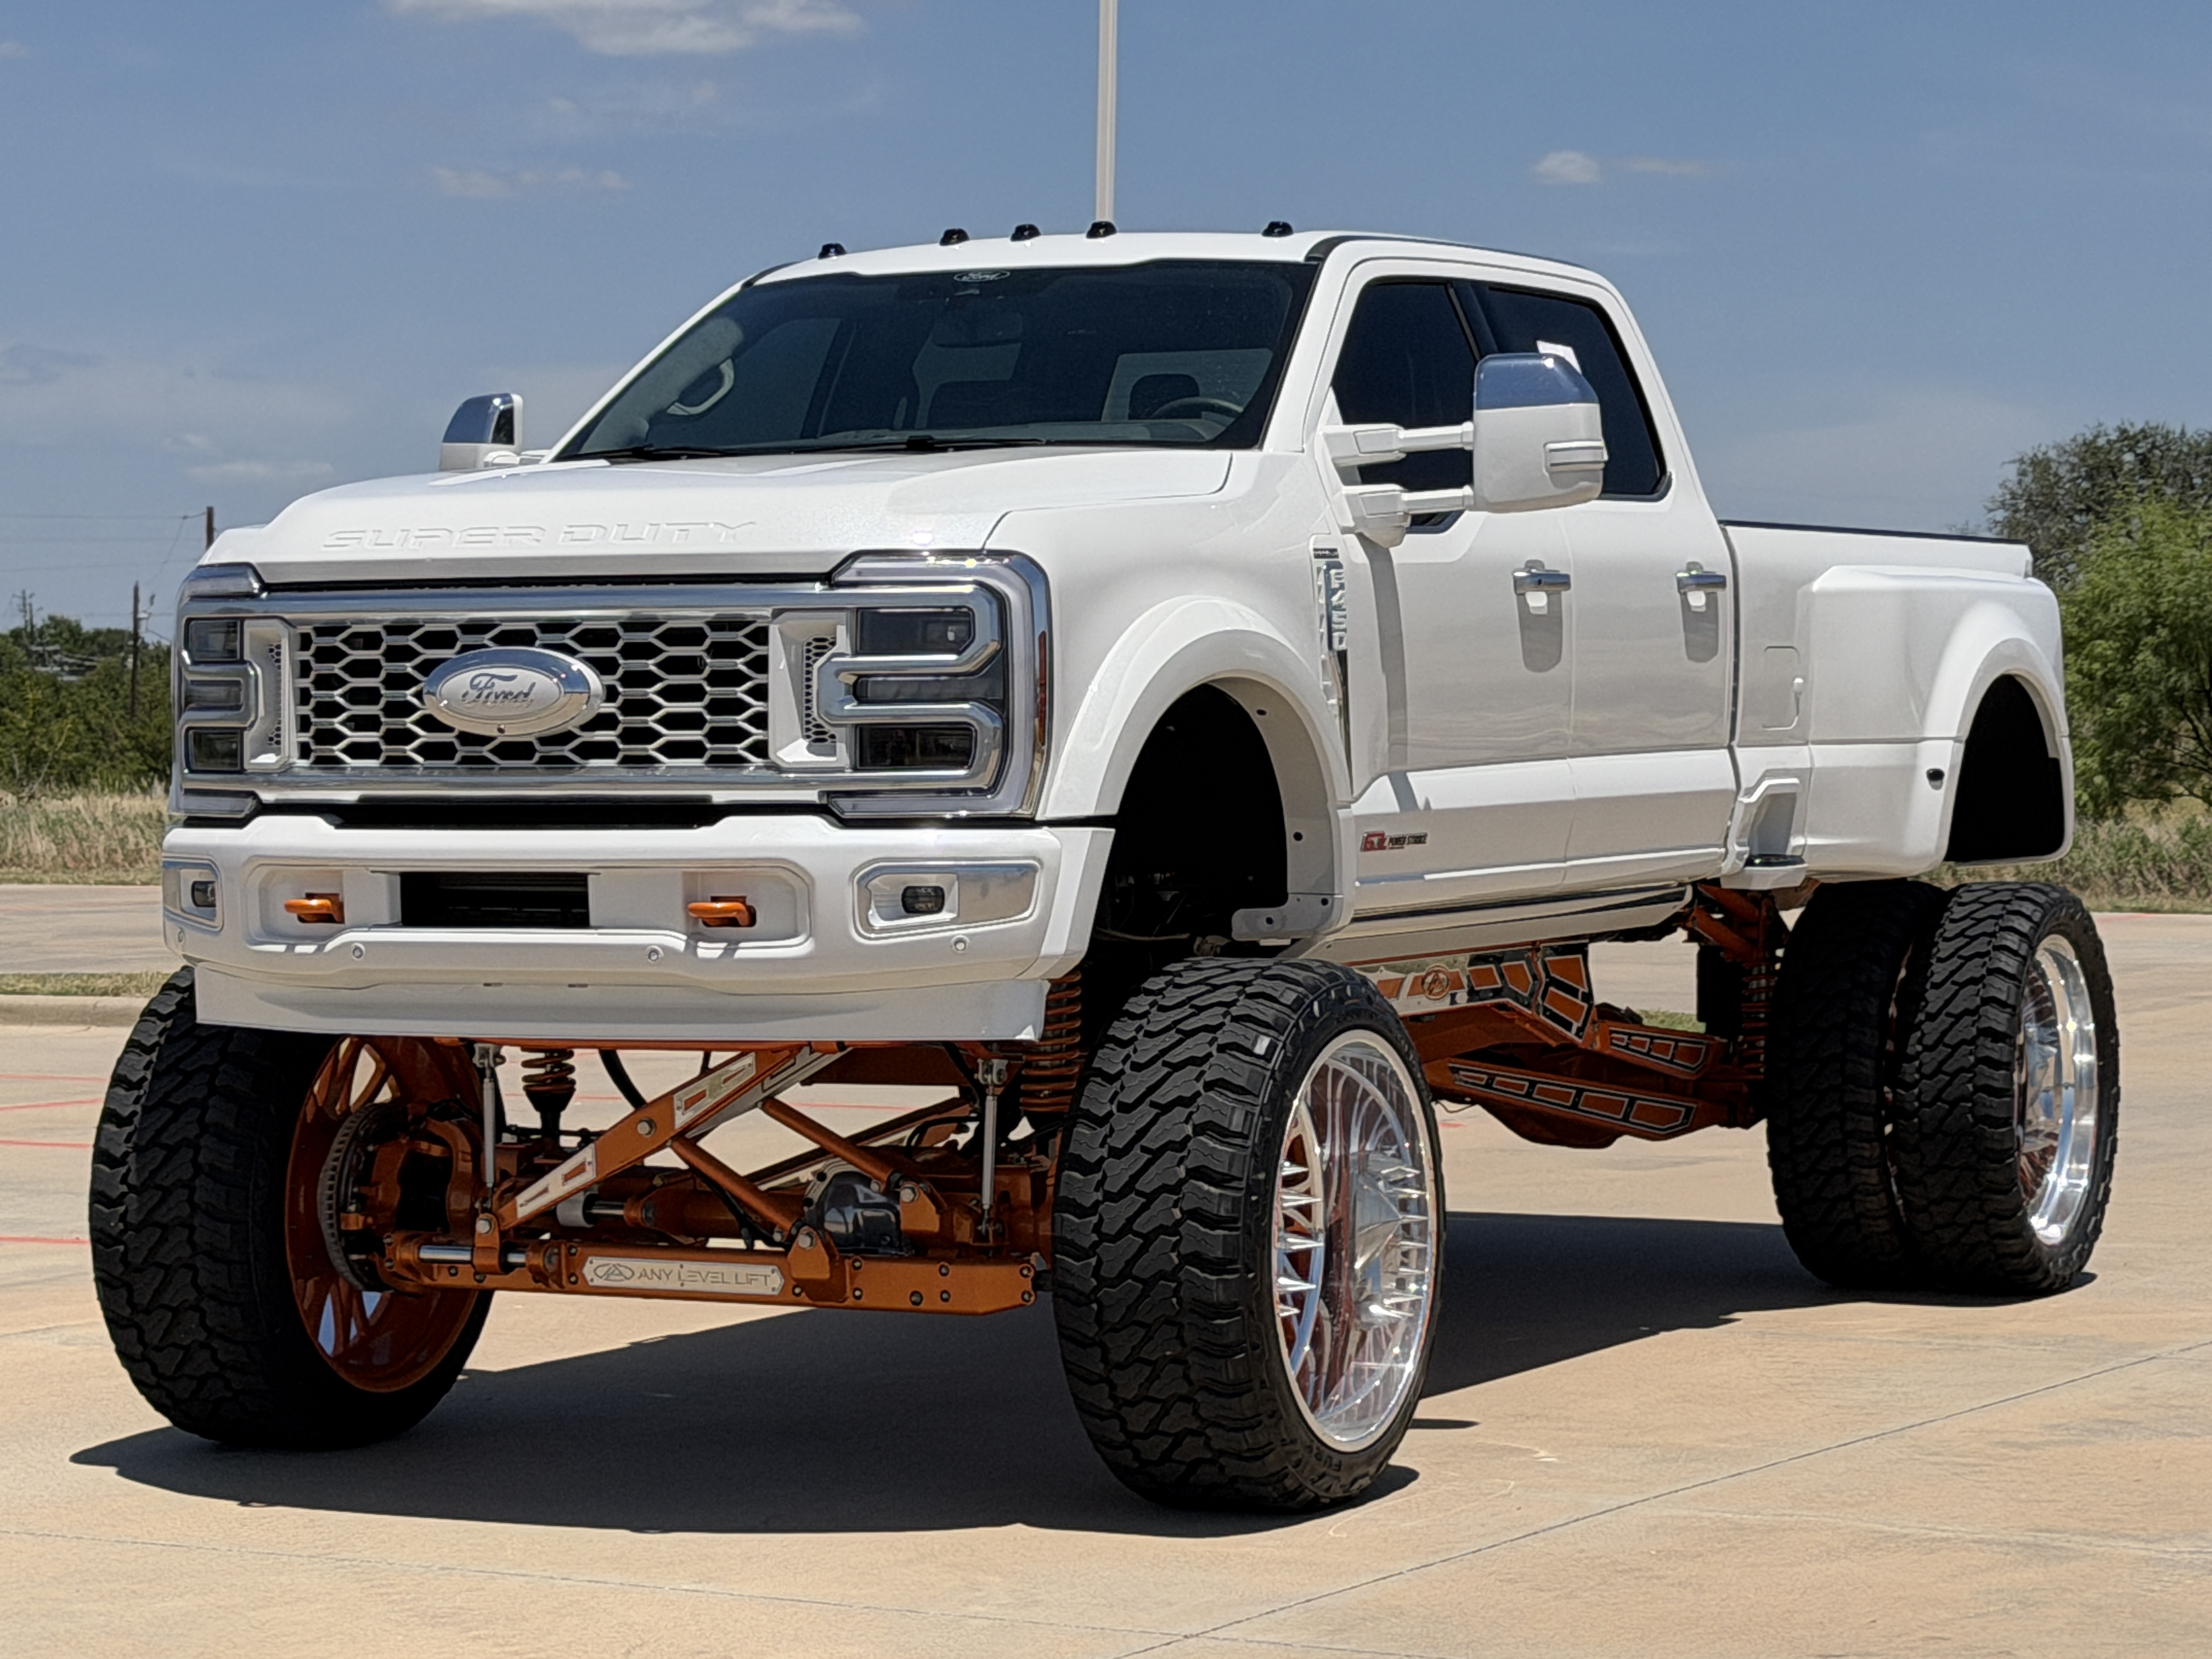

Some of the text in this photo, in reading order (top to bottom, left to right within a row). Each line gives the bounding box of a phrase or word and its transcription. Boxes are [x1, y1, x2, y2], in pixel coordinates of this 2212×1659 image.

[323, 521, 757, 550] SUPER DUTY
[461, 672, 537, 701] Ford
[637, 1267, 771, 1287] ANY LEVEL LIFT
